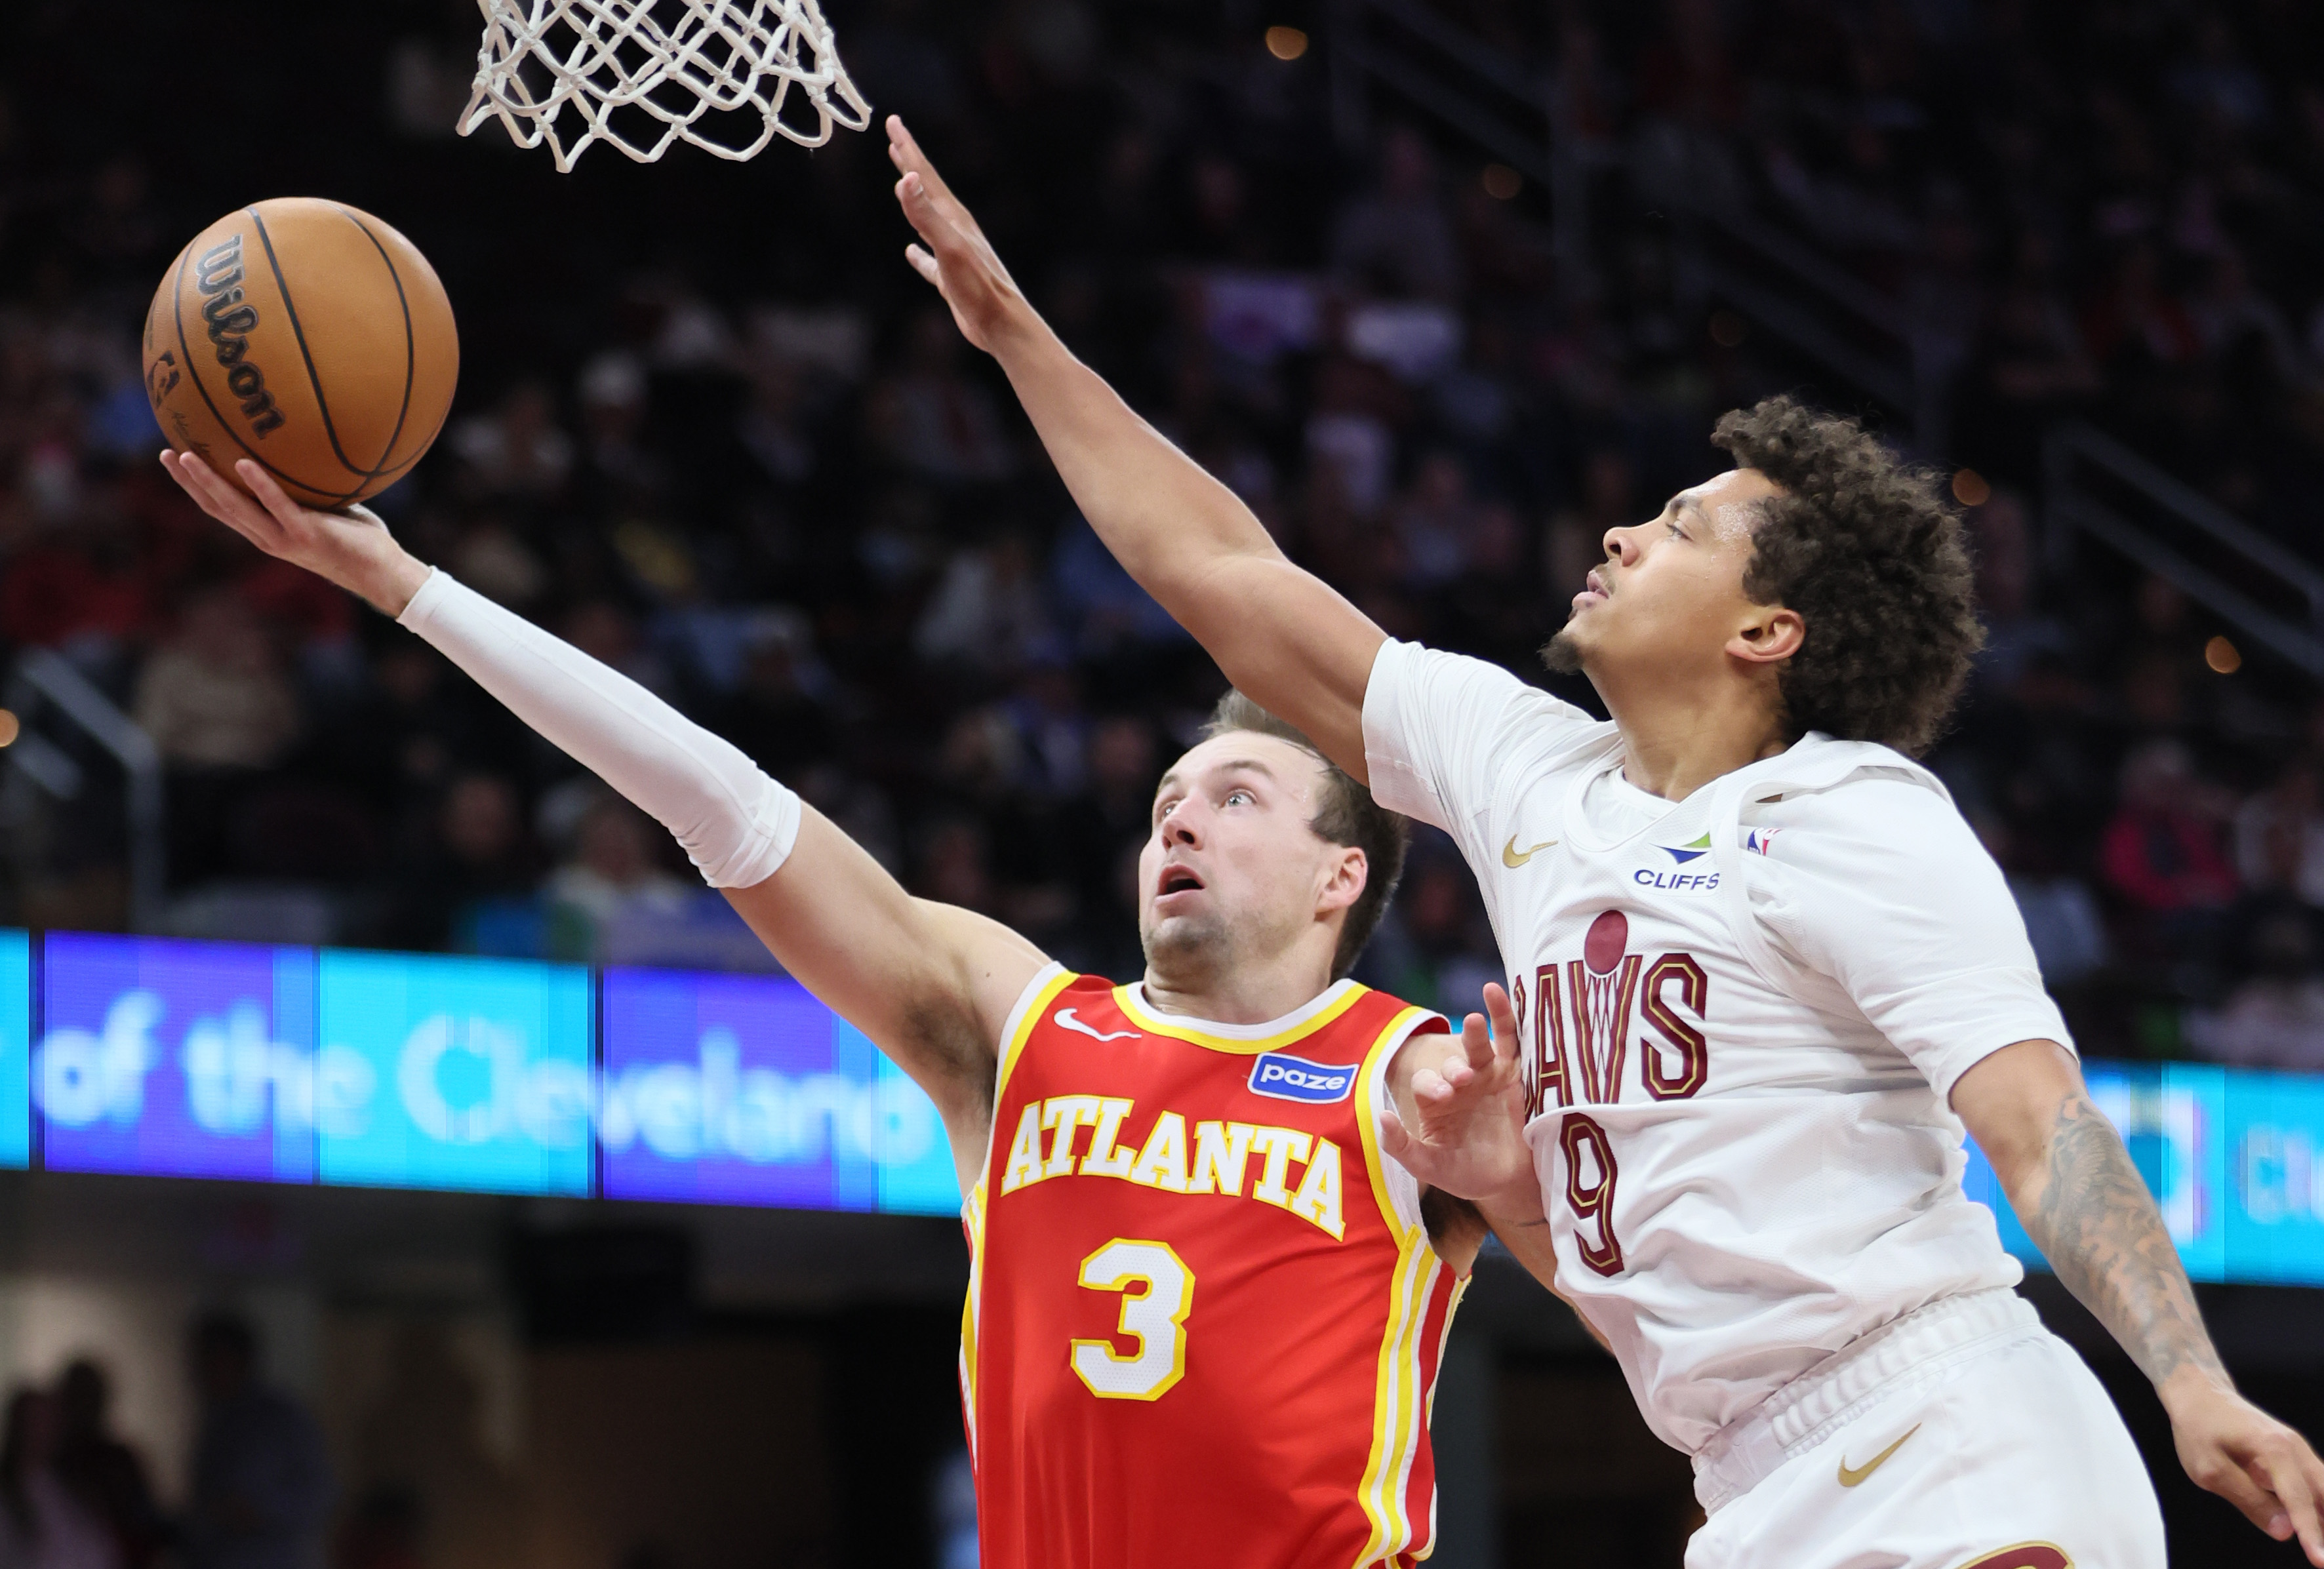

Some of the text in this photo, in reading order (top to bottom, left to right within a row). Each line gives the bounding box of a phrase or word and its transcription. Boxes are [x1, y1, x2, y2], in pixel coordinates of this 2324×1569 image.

[195, 233, 286, 441] Wilson
[1633, 868, 1719, 890] CLIFFS
[30, 990, 167, 1129] of
[184, 998, 378, 1139] the
[1259, 1063, 1346, 1091] paze
[1001, 1094, 1346, 1242] ATLANTA
[1559, 1112, 1625, 1278] 9
[1070, 1237, 1196, 1402] 3
